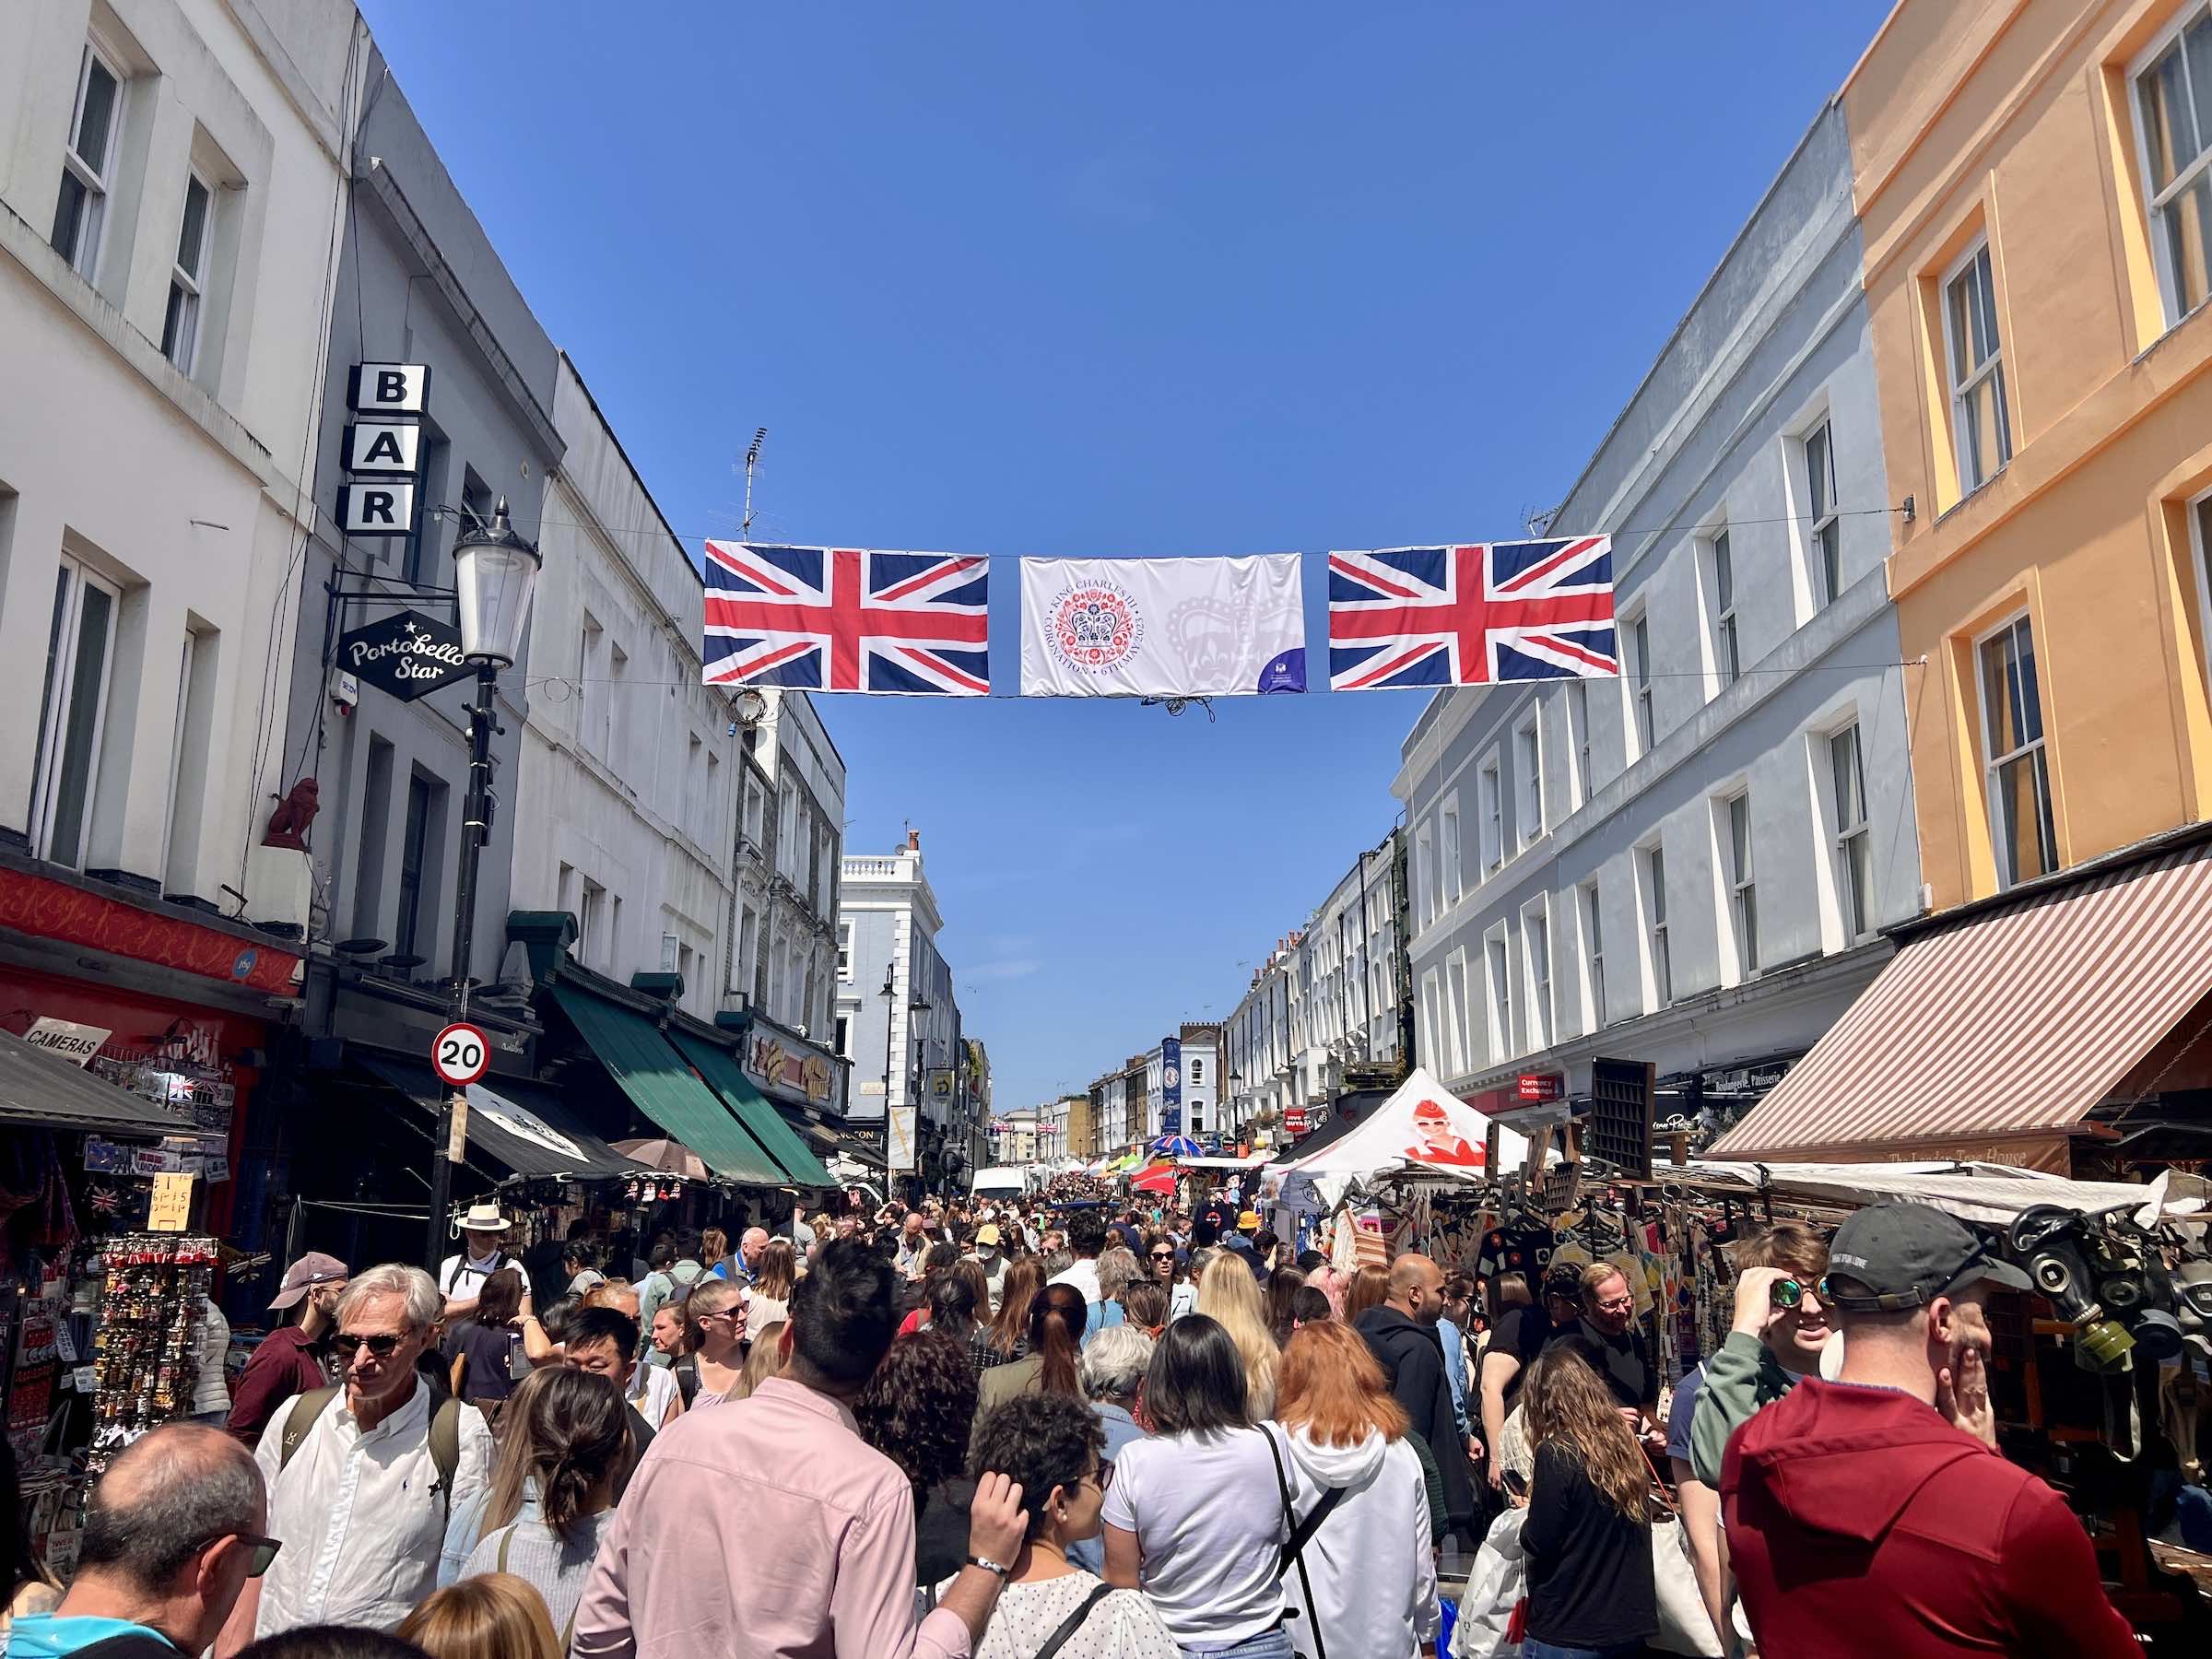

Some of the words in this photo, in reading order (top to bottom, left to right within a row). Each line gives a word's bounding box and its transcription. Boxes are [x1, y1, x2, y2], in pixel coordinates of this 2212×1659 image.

[362, 371, 408, 524] BAR
[1051, 585, 1075, 608] KING
[1076, 579, 1127, 598] CHARLES
[1124, 594, 1138, 609] III
[349, 633, 465, 667] Portobello
[1043, 616, 1089, 676] CORONATION
[1100, 661, 1123, 676] 6TH
[1121, 644, 1141, 665] MAY
[1136, 617, 1145, 642] 2023
[394, 657, 444, 680] Star
[28, 1030, 97, 1055] CAMERAS
[441, 1040, 481, 1068] 20
[1521, 1087, 1553, 1095] Exchange
[1986, 1146, 2028, 1167] House
